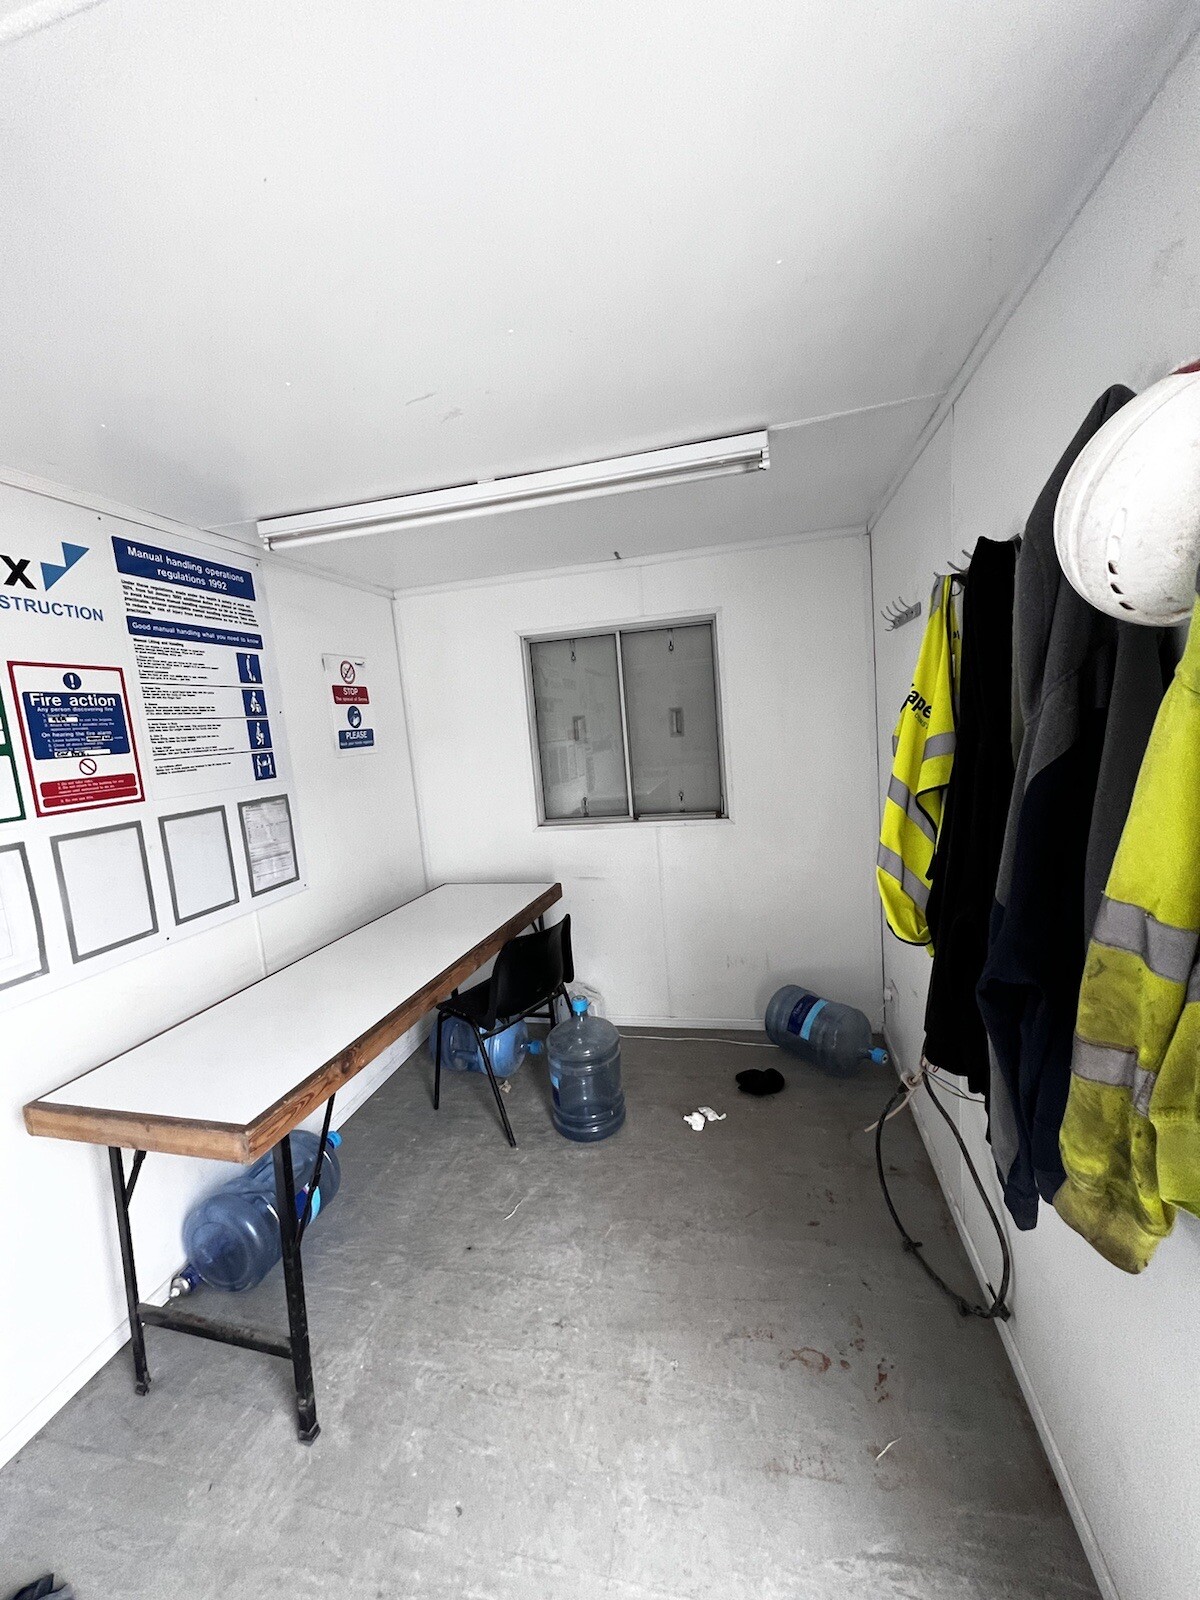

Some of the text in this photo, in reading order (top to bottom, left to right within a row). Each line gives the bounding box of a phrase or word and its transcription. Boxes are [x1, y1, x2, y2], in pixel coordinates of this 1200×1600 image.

[127, 546, 244, 583] Manual handling operations
[157, 568, 228, 590] regulations 1992
[0, 594, 104, 622] STRUCTION
[132, 622, 151, 630] Good
[176, 628, 200, 637] handling
[343, 687, 358, 696] STOP
[30, 693, 116, 706] Fire action
[346, 731, 368, 740] PLEASE
